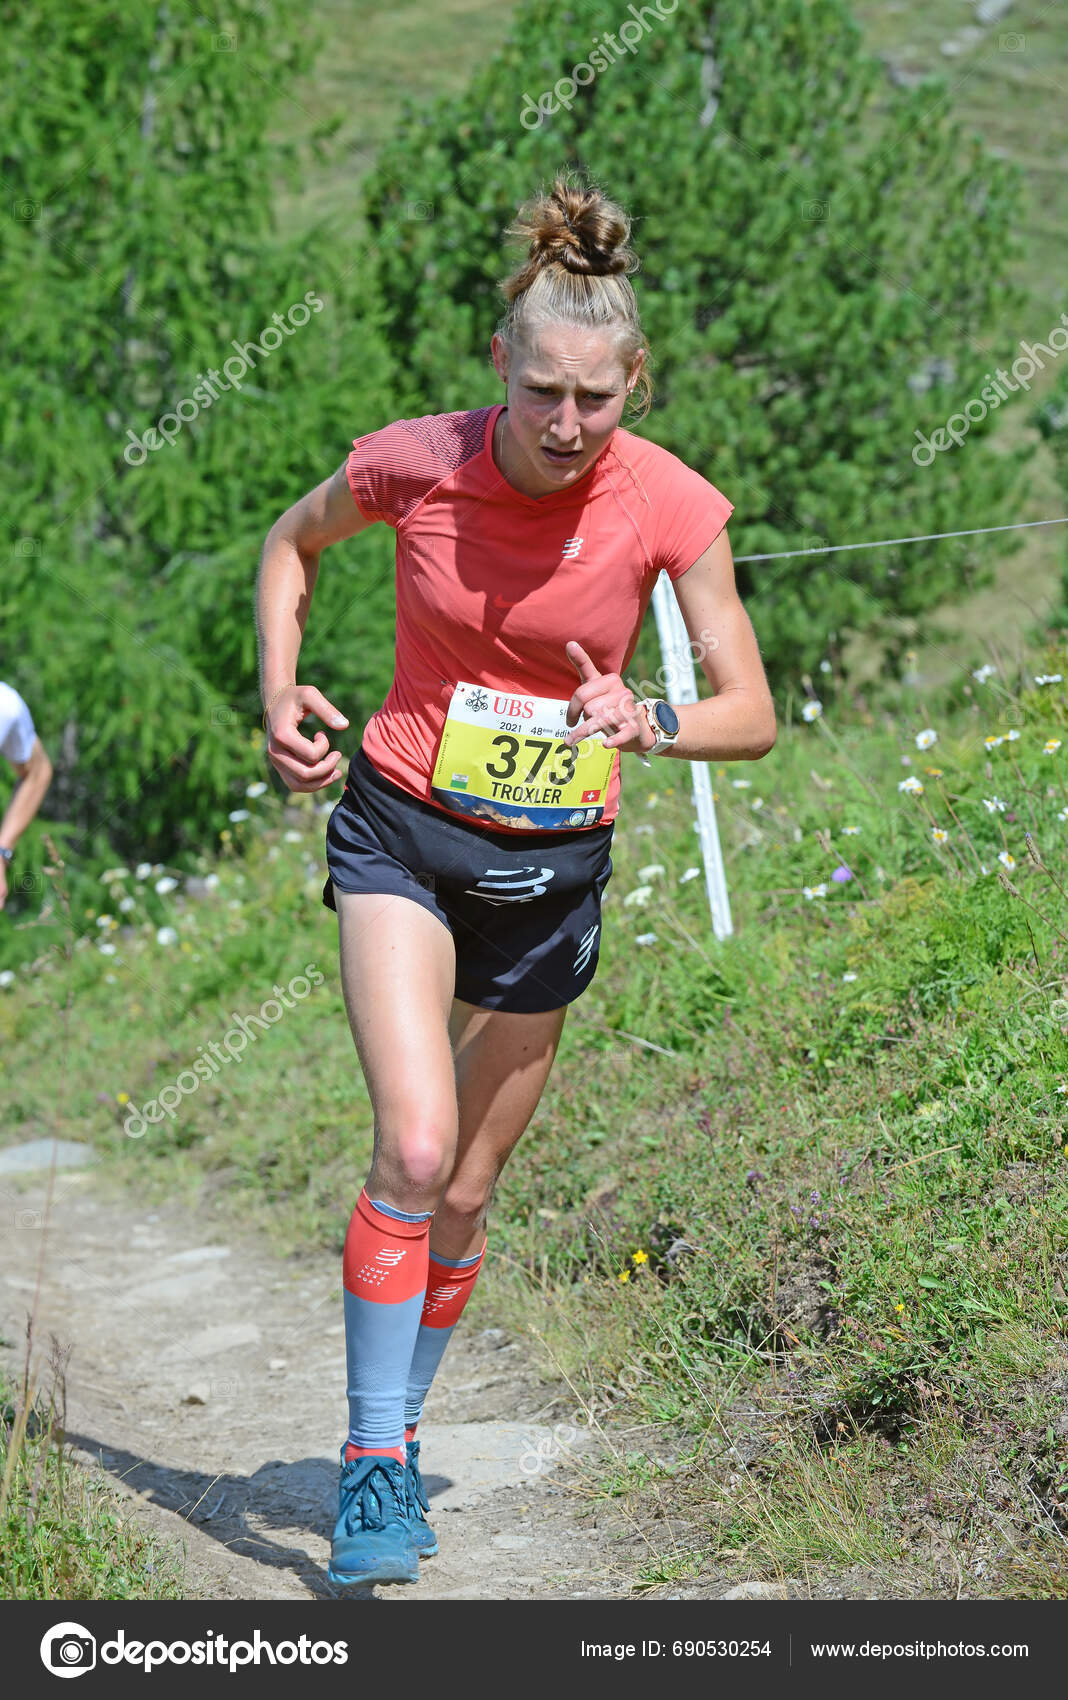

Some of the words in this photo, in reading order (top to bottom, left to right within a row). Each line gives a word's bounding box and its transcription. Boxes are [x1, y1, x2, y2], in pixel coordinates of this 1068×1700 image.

[493, 696, 535, 719] UBS
[500, 722, 522, 734] 2021
[486, 735, 579, 787] 373
[491, 782, 562, 804] TROXLER
